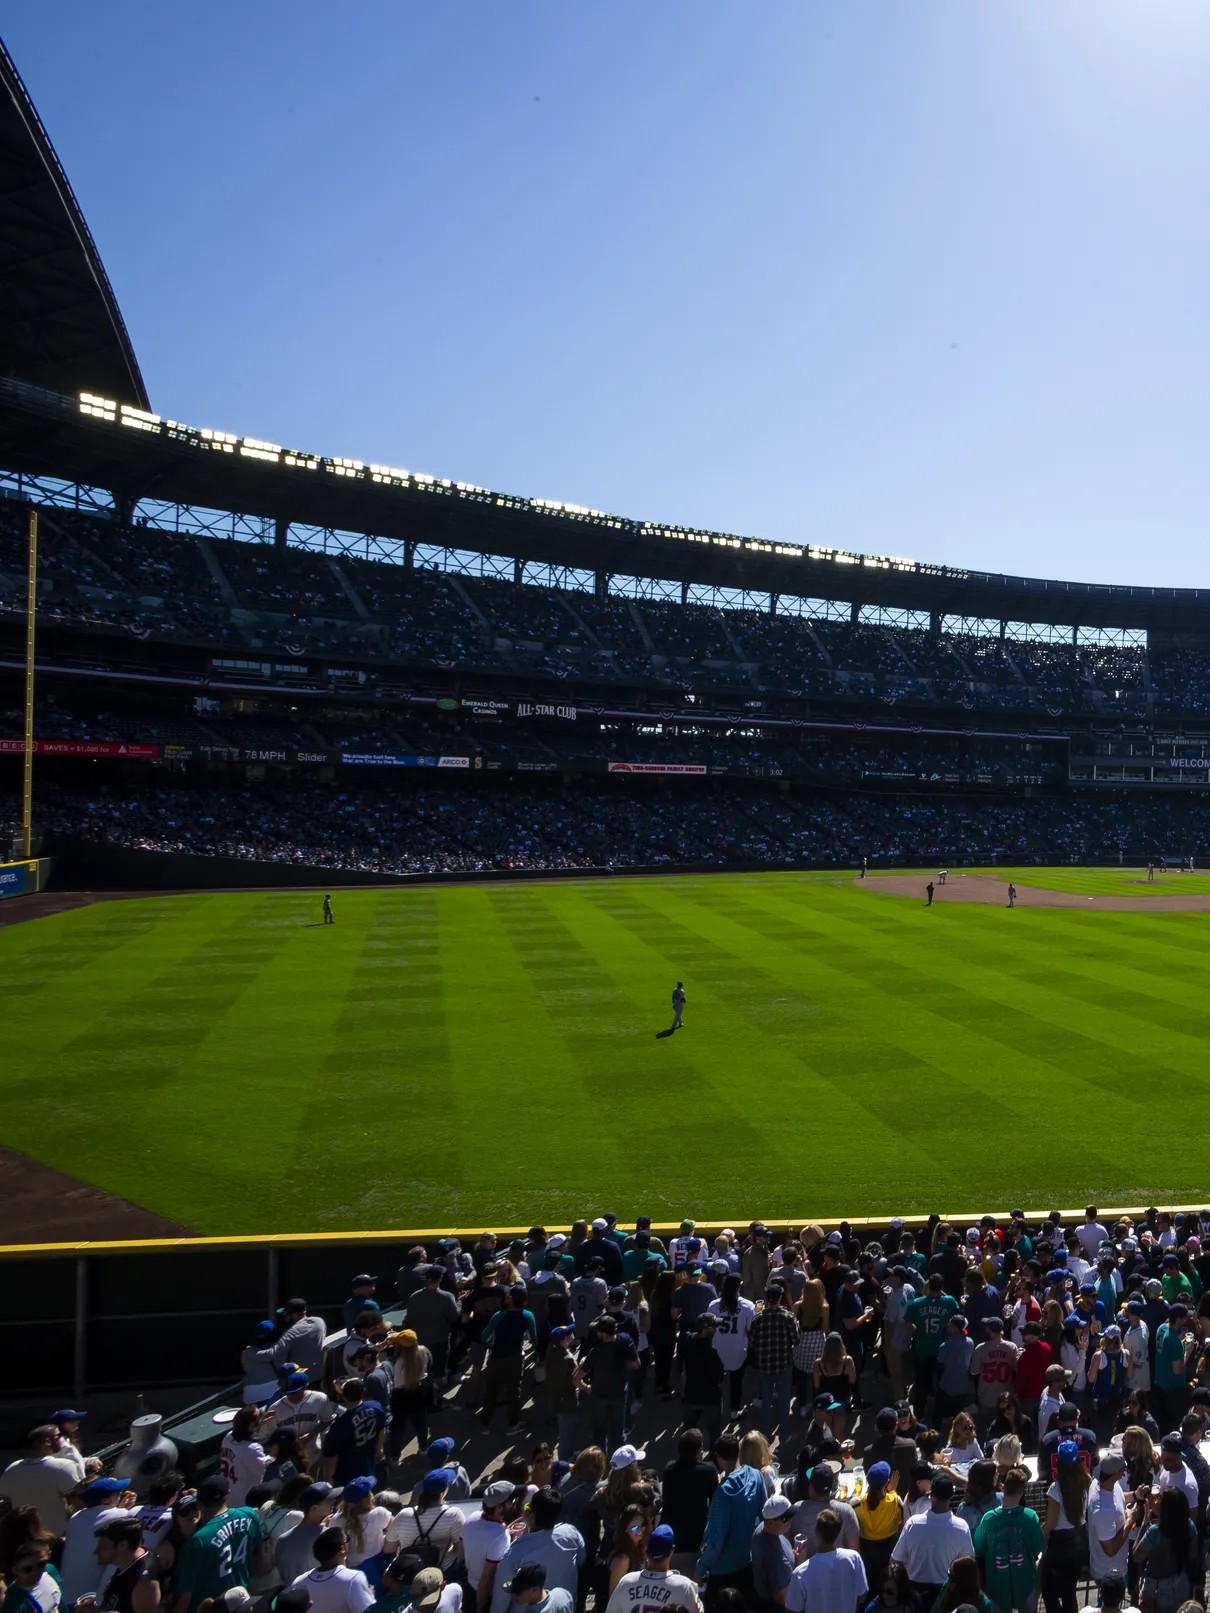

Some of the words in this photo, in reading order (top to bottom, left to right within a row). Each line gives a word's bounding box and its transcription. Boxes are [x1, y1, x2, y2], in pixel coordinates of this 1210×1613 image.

[461, 699, 488, 708] EMERALD
[489, 700, 509, 710] QUEEN
[472, 706, 498, 716] CASINOS
[556, 706, 577, 721] CLUB
[245, 750, 258, 760] 78
[259, 751, 286, 761] MPH
[297, 752, 328, 762] Slider
[578, 1295, 587, 1310] 9
[919, 1306, 947, 1317] SEAGER
[719, 1315, 738, 1335] 51
[924, 1318, 940, 1334] 15
[983, 1361, 1011, 1384] 50
[354, 1417, 377, 1448] 52
[211, 1517, 253, 1548] GRIFFEY
[219, 1535, 249, 1578] 24
[628, 1585, 671, 1604] SEAGER
